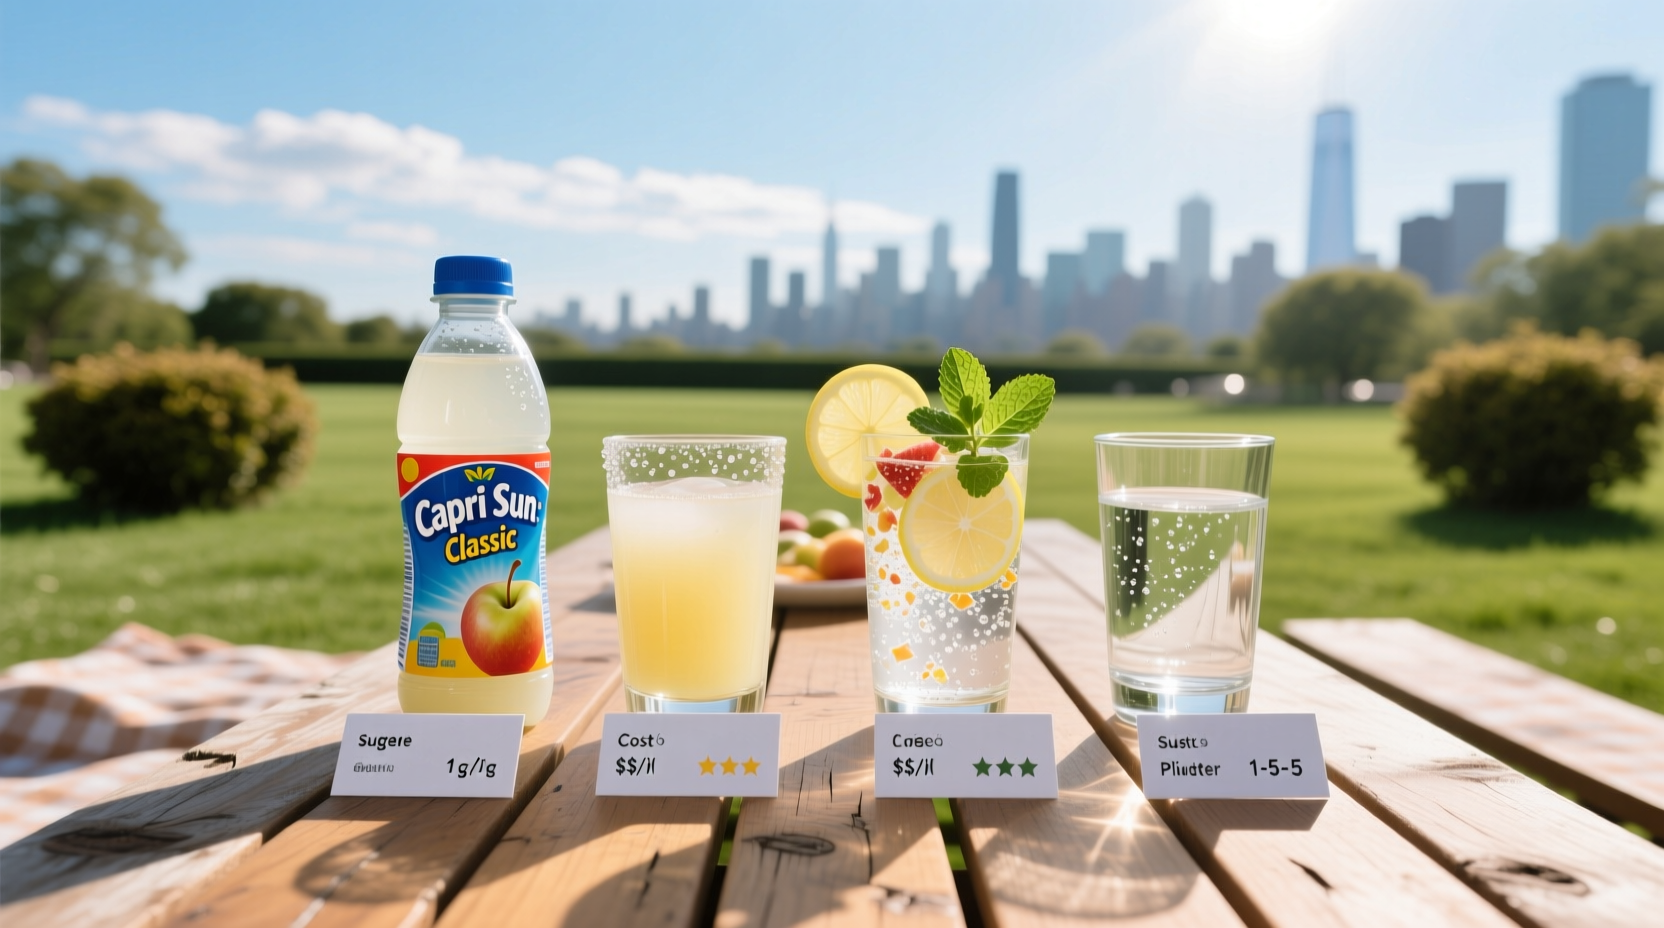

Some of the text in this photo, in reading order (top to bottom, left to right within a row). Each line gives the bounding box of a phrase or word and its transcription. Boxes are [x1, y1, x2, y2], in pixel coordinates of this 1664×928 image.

[415, 485, 487, 537] Capri
[445, 524, 517, 563] Classic
[1249, 759, 1303, 776] 1-5-5
